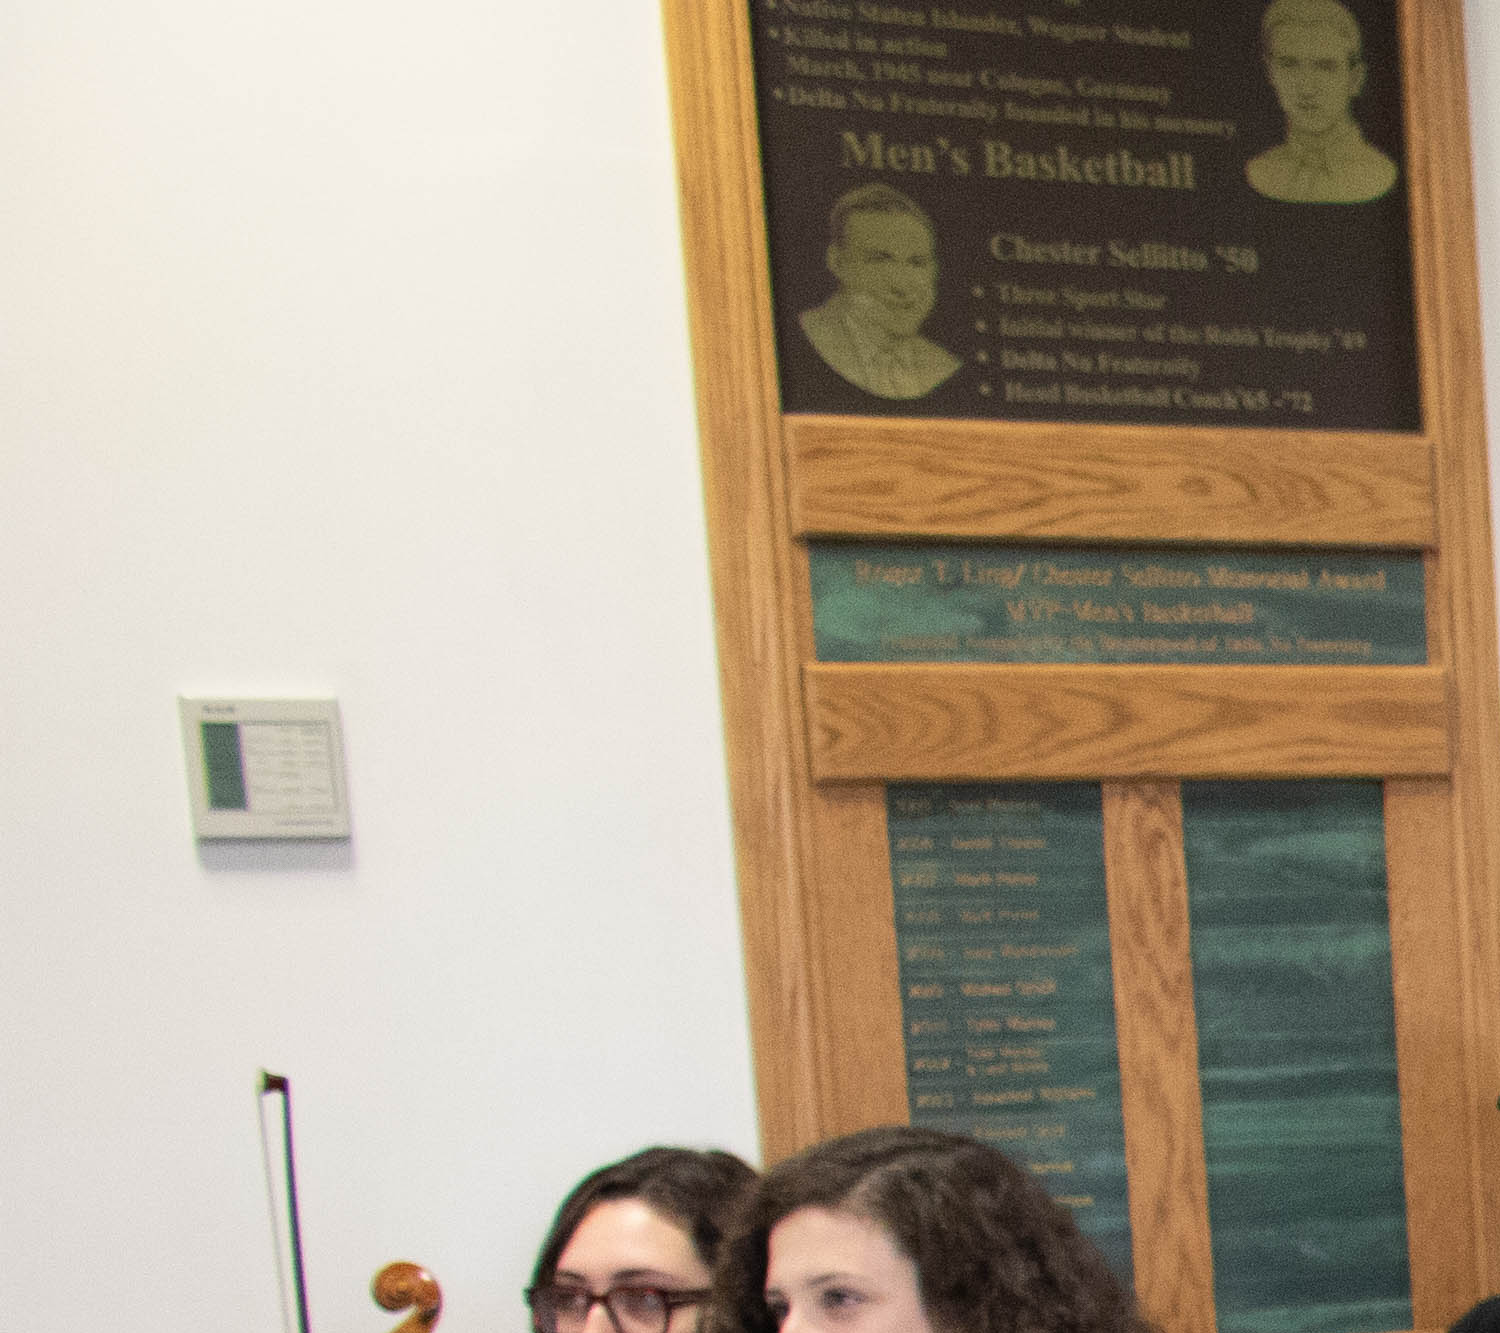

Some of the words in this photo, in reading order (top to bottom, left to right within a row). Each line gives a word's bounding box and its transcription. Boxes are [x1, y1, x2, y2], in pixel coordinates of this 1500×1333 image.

[840, 130, 970, 175] Men's
[984, 140, 1195, 191] Basketball
[990, 233, 1101, 265] Chester
[1001, 350, 1057, 371] Delta
[1098, 352, 1200, 381] Fraternity
[1064, 383, 1170, 407] Basketball
